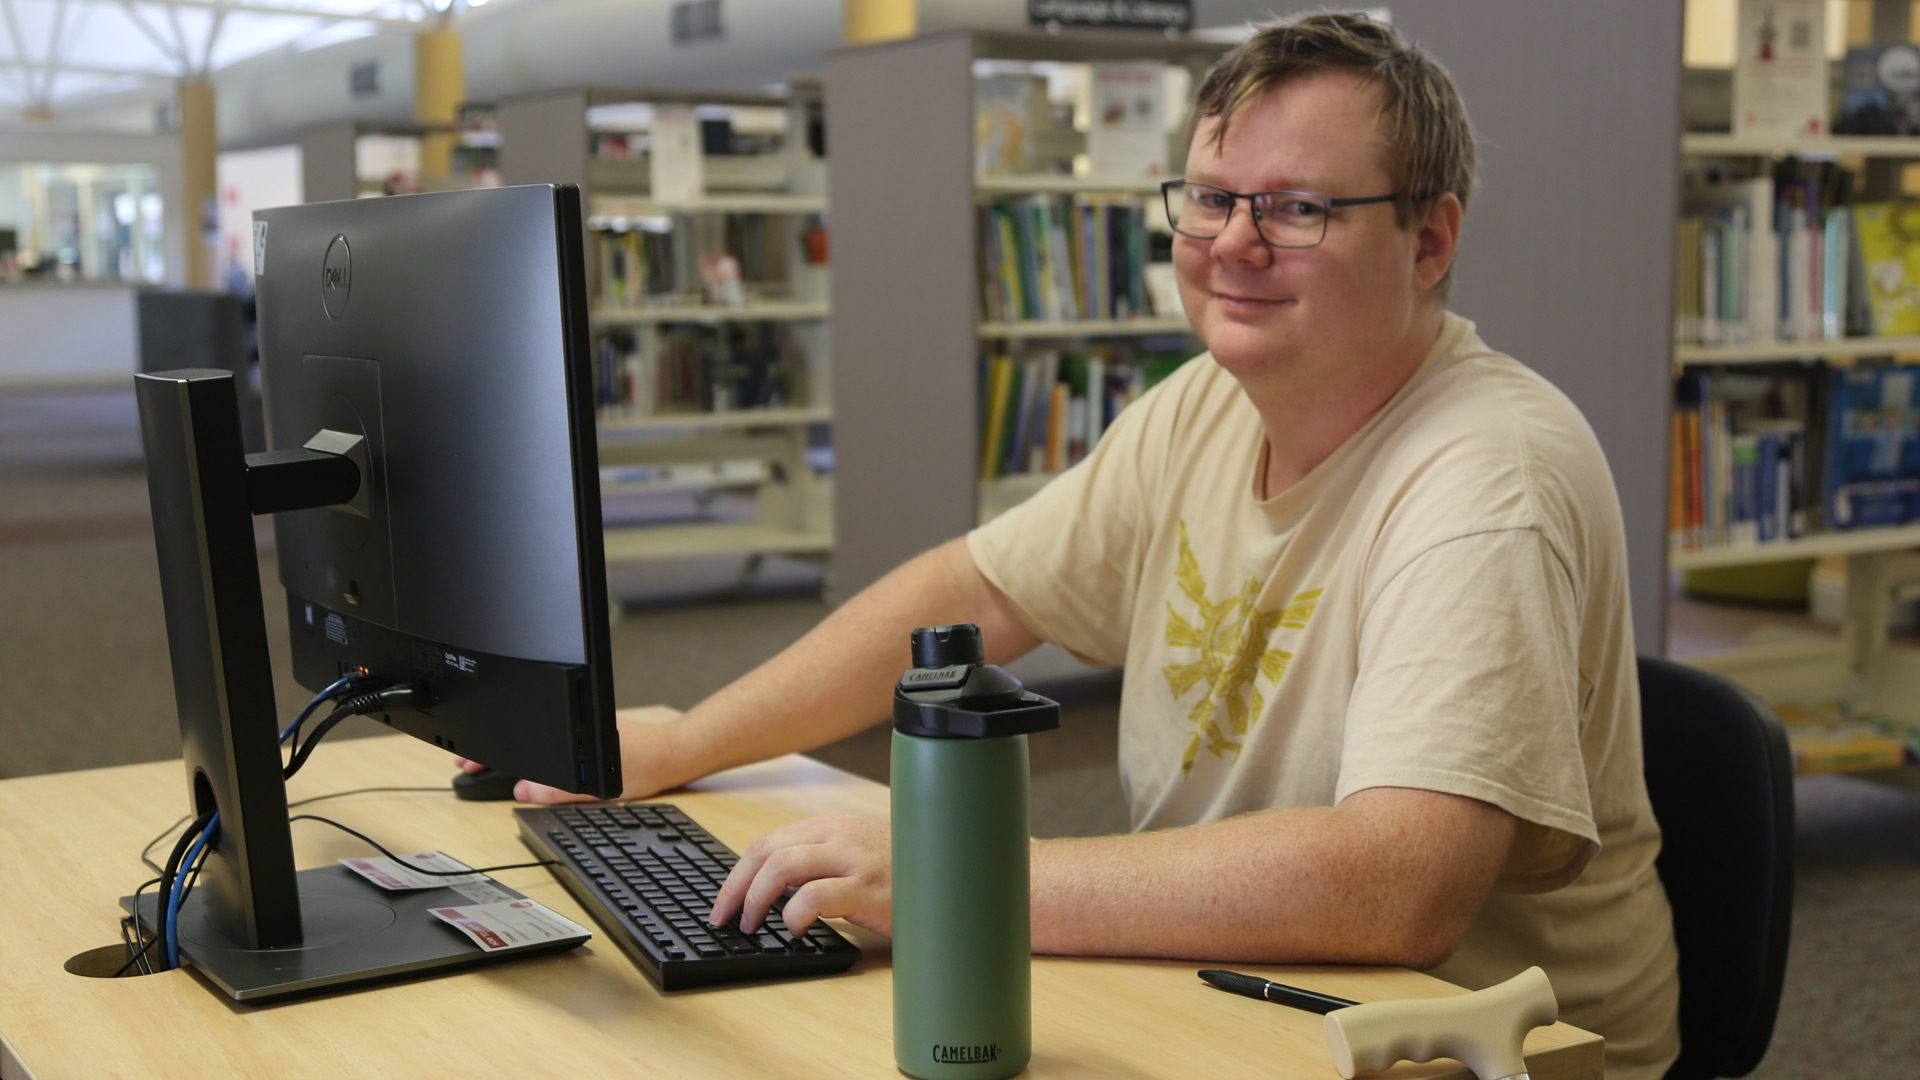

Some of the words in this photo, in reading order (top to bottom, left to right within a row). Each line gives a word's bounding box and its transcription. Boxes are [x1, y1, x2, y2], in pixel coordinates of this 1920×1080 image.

[326, 267, 348, 288] DELL
[909, 670, 957, 682] CAMELBAK
[932, 1044, 998, 1063] CAMELBAK
